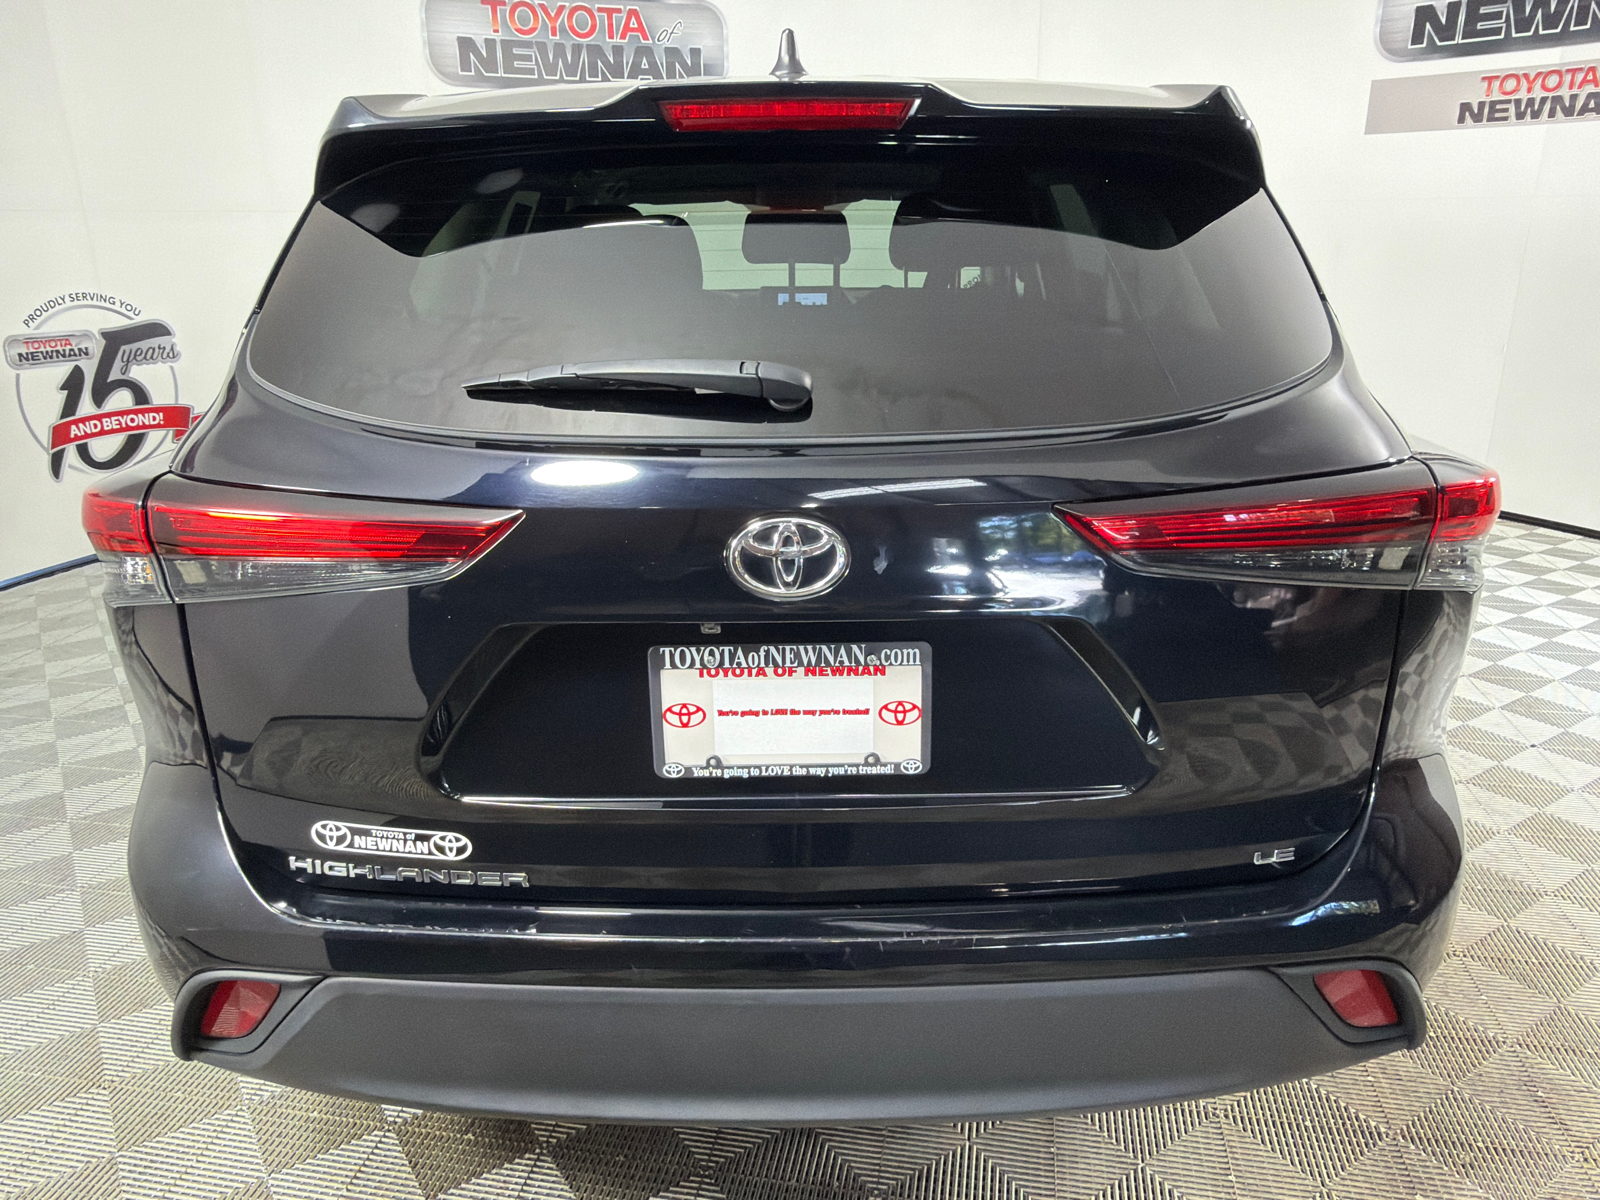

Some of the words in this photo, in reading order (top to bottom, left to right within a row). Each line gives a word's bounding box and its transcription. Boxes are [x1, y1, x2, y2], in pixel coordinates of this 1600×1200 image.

[480, 0, 651, 43] TOYOTA
[655, 20, 683, 45] of
[456, 35, 705, 82] NEWNAN
[1480, 65, 1600, 98] TOYOTA
[1456, 91, 1600, 126] NEWNA
[962, 274, 981, 289] PRO
[22, 294, 67, 329] PROUDLY
[68, 291, 117, 306] SERVING
[118, 298, 142, 317] YOU
[17, 346, 89, 363] NEWNAN
[22, 338, 73, 351] TOYOTA
[49, 321, 174, 481] 15
[120, 341, 180, 376] years
[70, 419, 102, 439] AND
[103, 412, 165, 431] BEYOND!
[695, 667, 768, 679] TOYOTA
[772, 667, 798, 678] OF
[804, 666, 886, 677] NEWNAN
[717, 709, 739, 717] You're
[740, 709, 761, 718] going
[762, 709, 769, 717] to
[802, 709, 817, 717] way
[692, 766, 722, 777] You're
[723, 766, 749, 778] going
[750, 766, 760, 776] to
[761, 765, 791, 776] LOVE
[792, 765, 807, 776] the
[808, 767, 826, 778] way
[827, 765, 857, 777] you're
[858, 764, 895, 775] treated!
[353, 834, 430, 855] NEWNAN
[370, 829, 405, 841] TOYOTA
[405, 832, 416, 841] of
[1253, 847, 1296, 865] LE
[288, 855, 531, 889] HIGHLANDER
